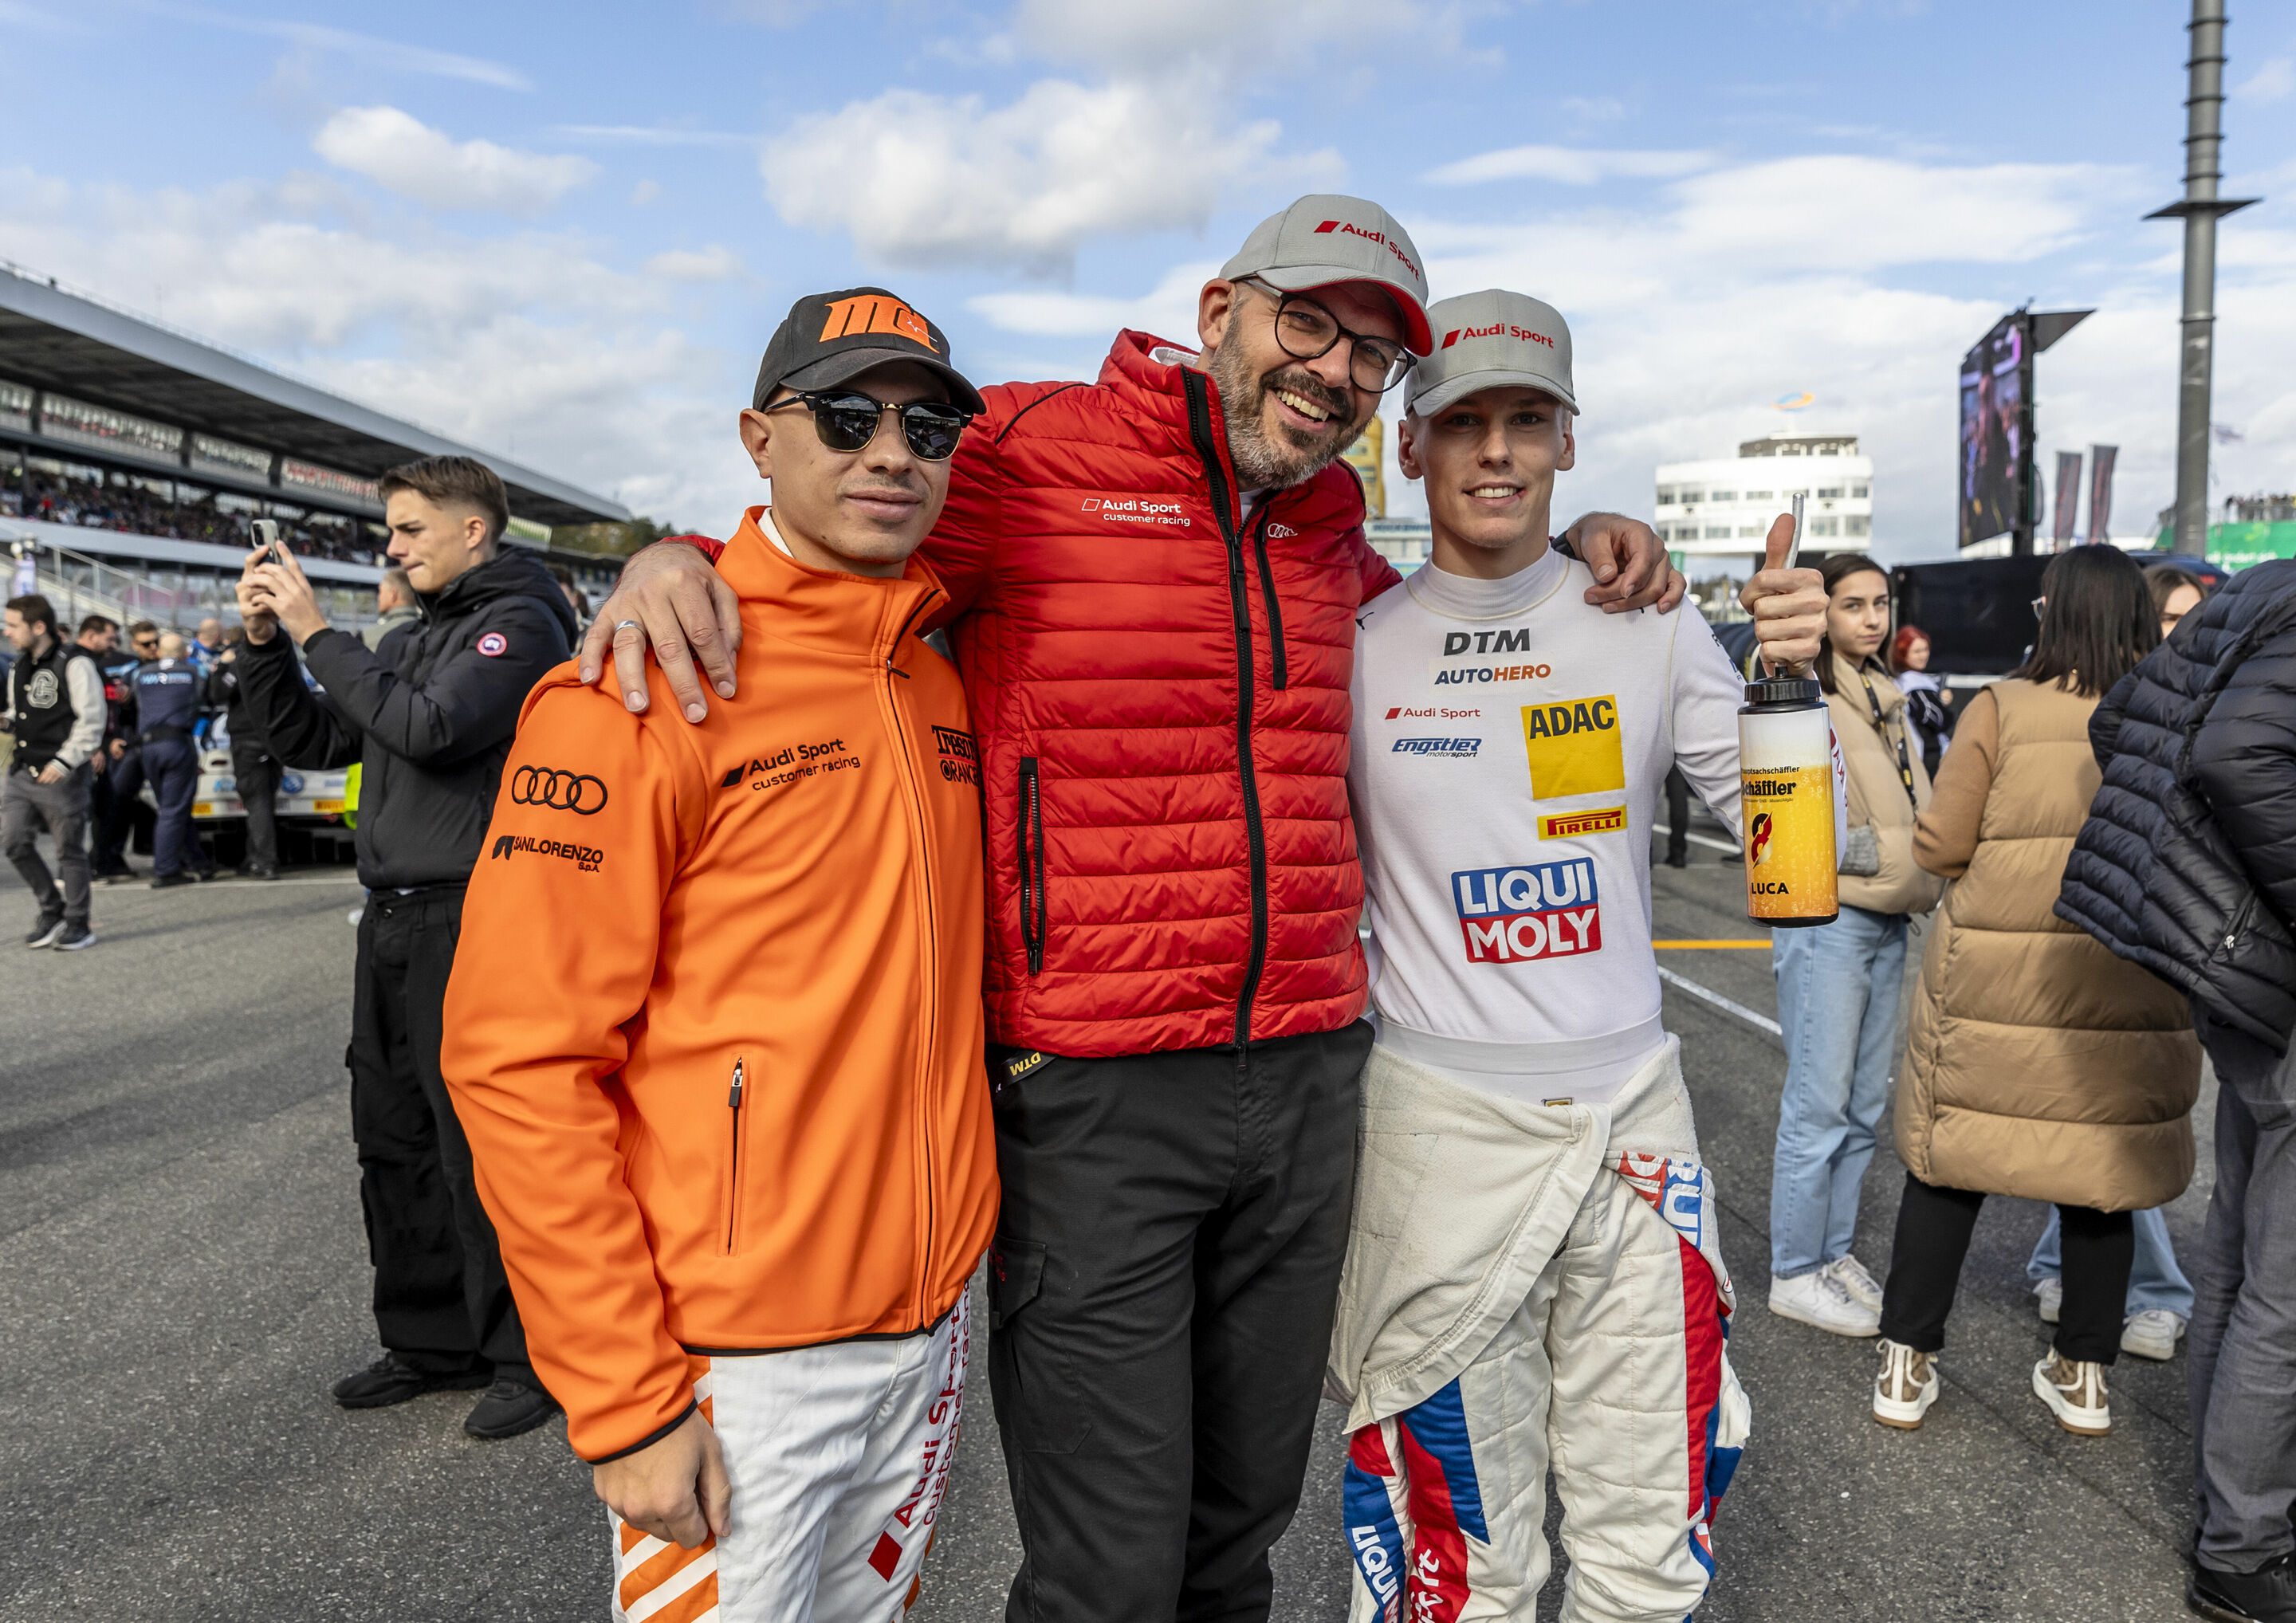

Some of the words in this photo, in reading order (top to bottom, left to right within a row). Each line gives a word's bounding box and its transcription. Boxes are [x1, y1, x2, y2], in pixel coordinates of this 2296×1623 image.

[1341, 222, 1386, 246] Audi
[1388, 240, 1421, 282] Sport
[1462, 323, 1506, 340] Audi
[1510, 324, 1555, 349] Sport
[1103, 499, 1138, 511] Audi
[1140, 501, 1181, 514] Sport
[1103, 513, 1156, 524] customer
[1158, 516, 1190, 527] racing
[1443, 628, 1531, 656] DTM
[1434, 663, 1551, 686] AUTOHERO
[1403, 707, 1436, 717] Audi
[1441, 708, 1481, 720] Sport
[1529, 699, 1615, 740] ADAC
[748, 748, 796, 776] Audi
[797, 738, 847, 760] Sport
[1391, 737, 1482, 755] Engstler
[752, 764, 820, 791] customer
[822, 756, 861, 772] racing
[1547, 810, 1622, 836] PIRELLI
[513, 835, 603, 864] SANLORENZO
[1459, 862, 1591, 914] LIQUI
[1751, 882, 1790, 894] LUCA
[1466, 907, 1597, 960] MOLY
[1009, 1051, 1042, 1076] DTM
[894, 1439, 941, 1529] Audi
[928, 1306, 960, 1425] Sport
[923, 1380, 964, 1526] customer
[1351, 1525, 1399, 1605] LIQUI
